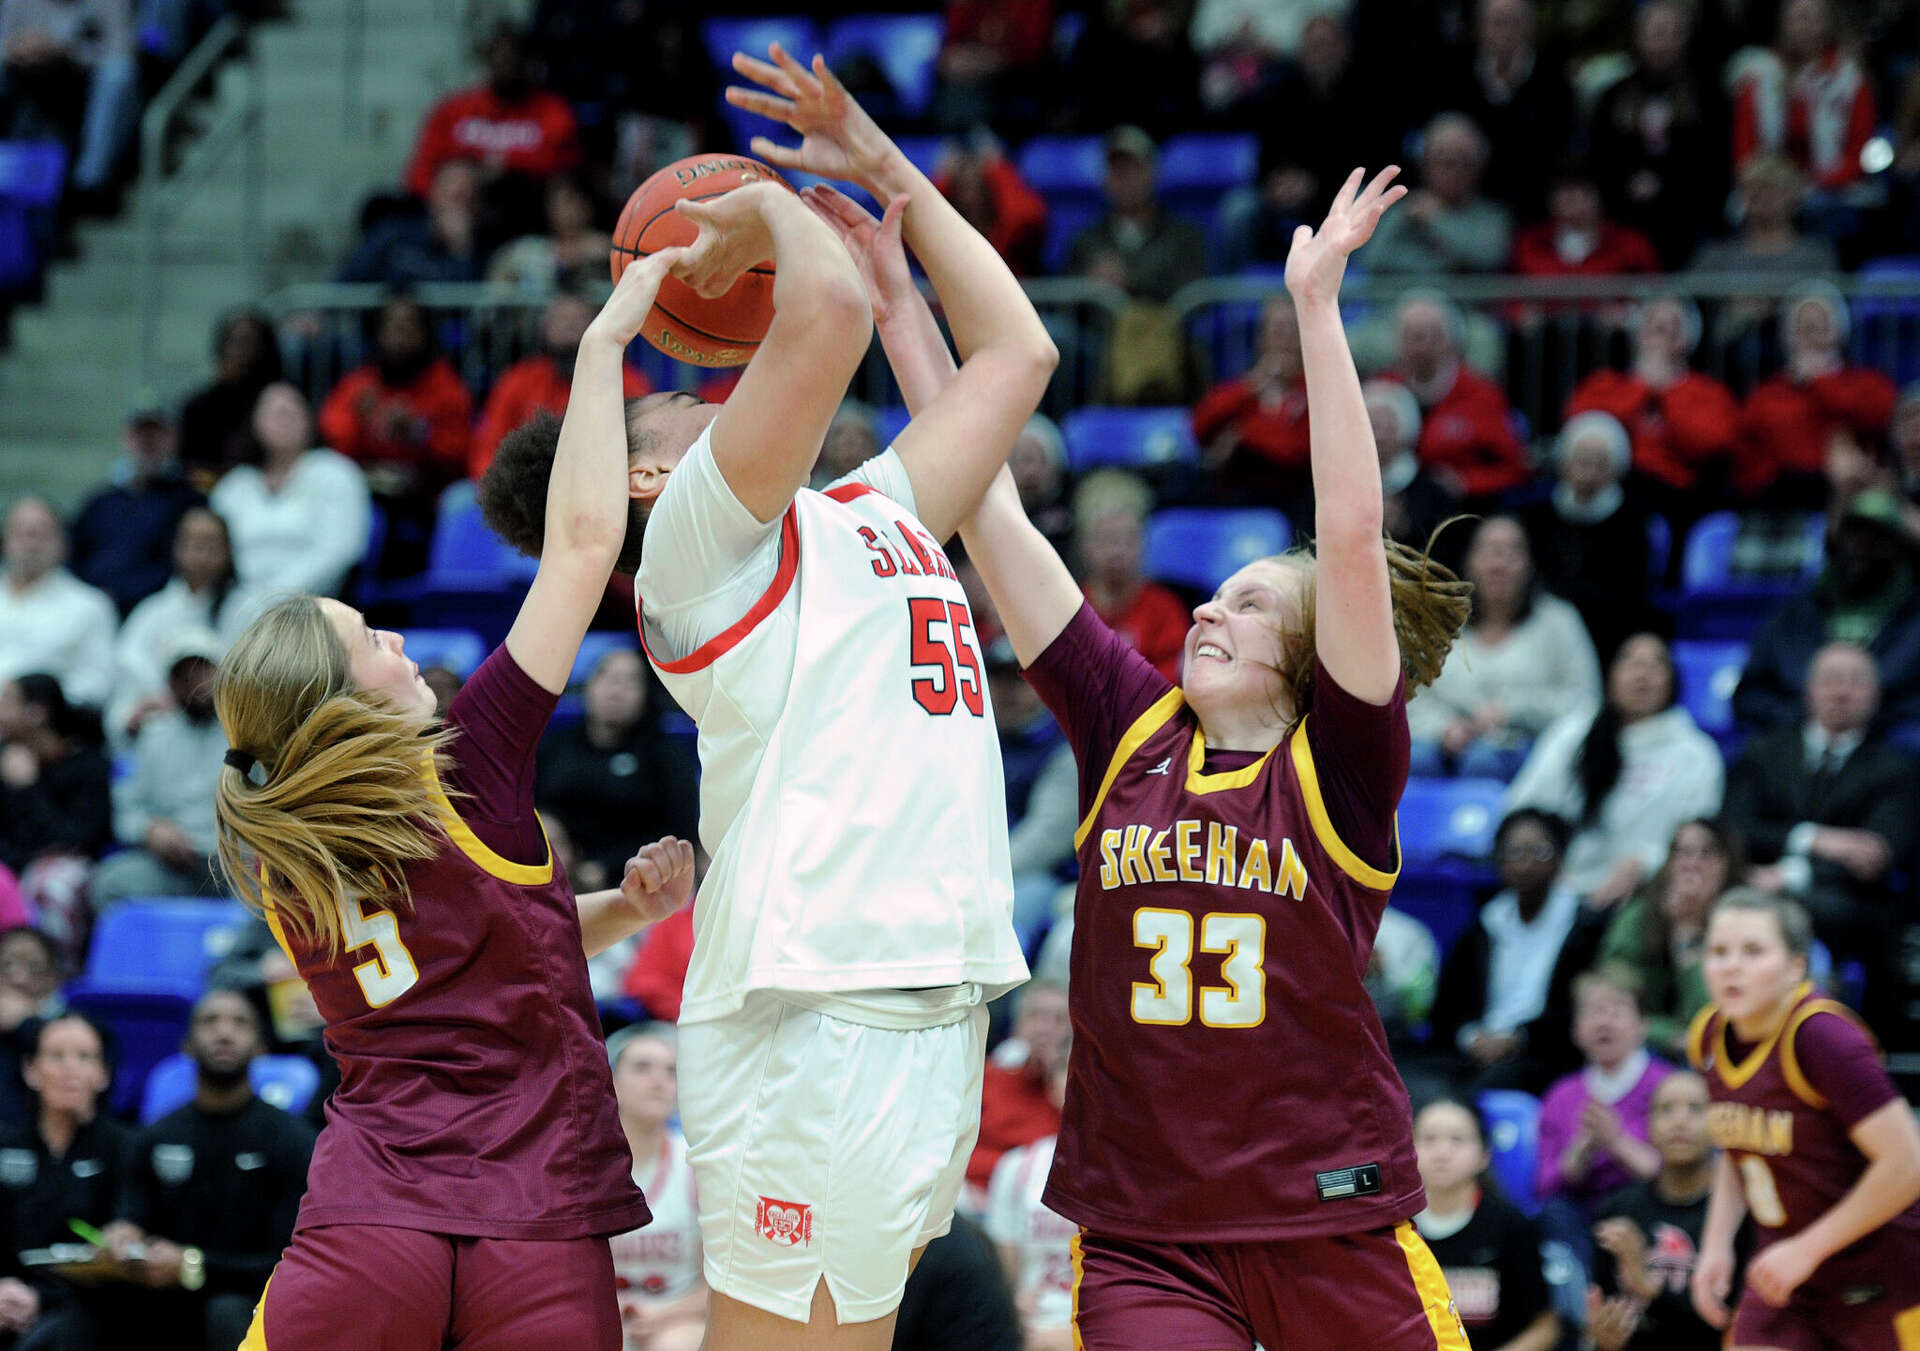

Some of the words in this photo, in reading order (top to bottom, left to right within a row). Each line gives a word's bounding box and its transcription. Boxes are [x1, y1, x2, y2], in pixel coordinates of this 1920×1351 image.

[906, 596, 985, 718] 55
[1099, 819, 1309, 902] SHEEHAN
[334, 866, 420, 1009] 5
[1131, 907, 1267, 1029] 33
[1361, 1173, 1373, 1187] L
